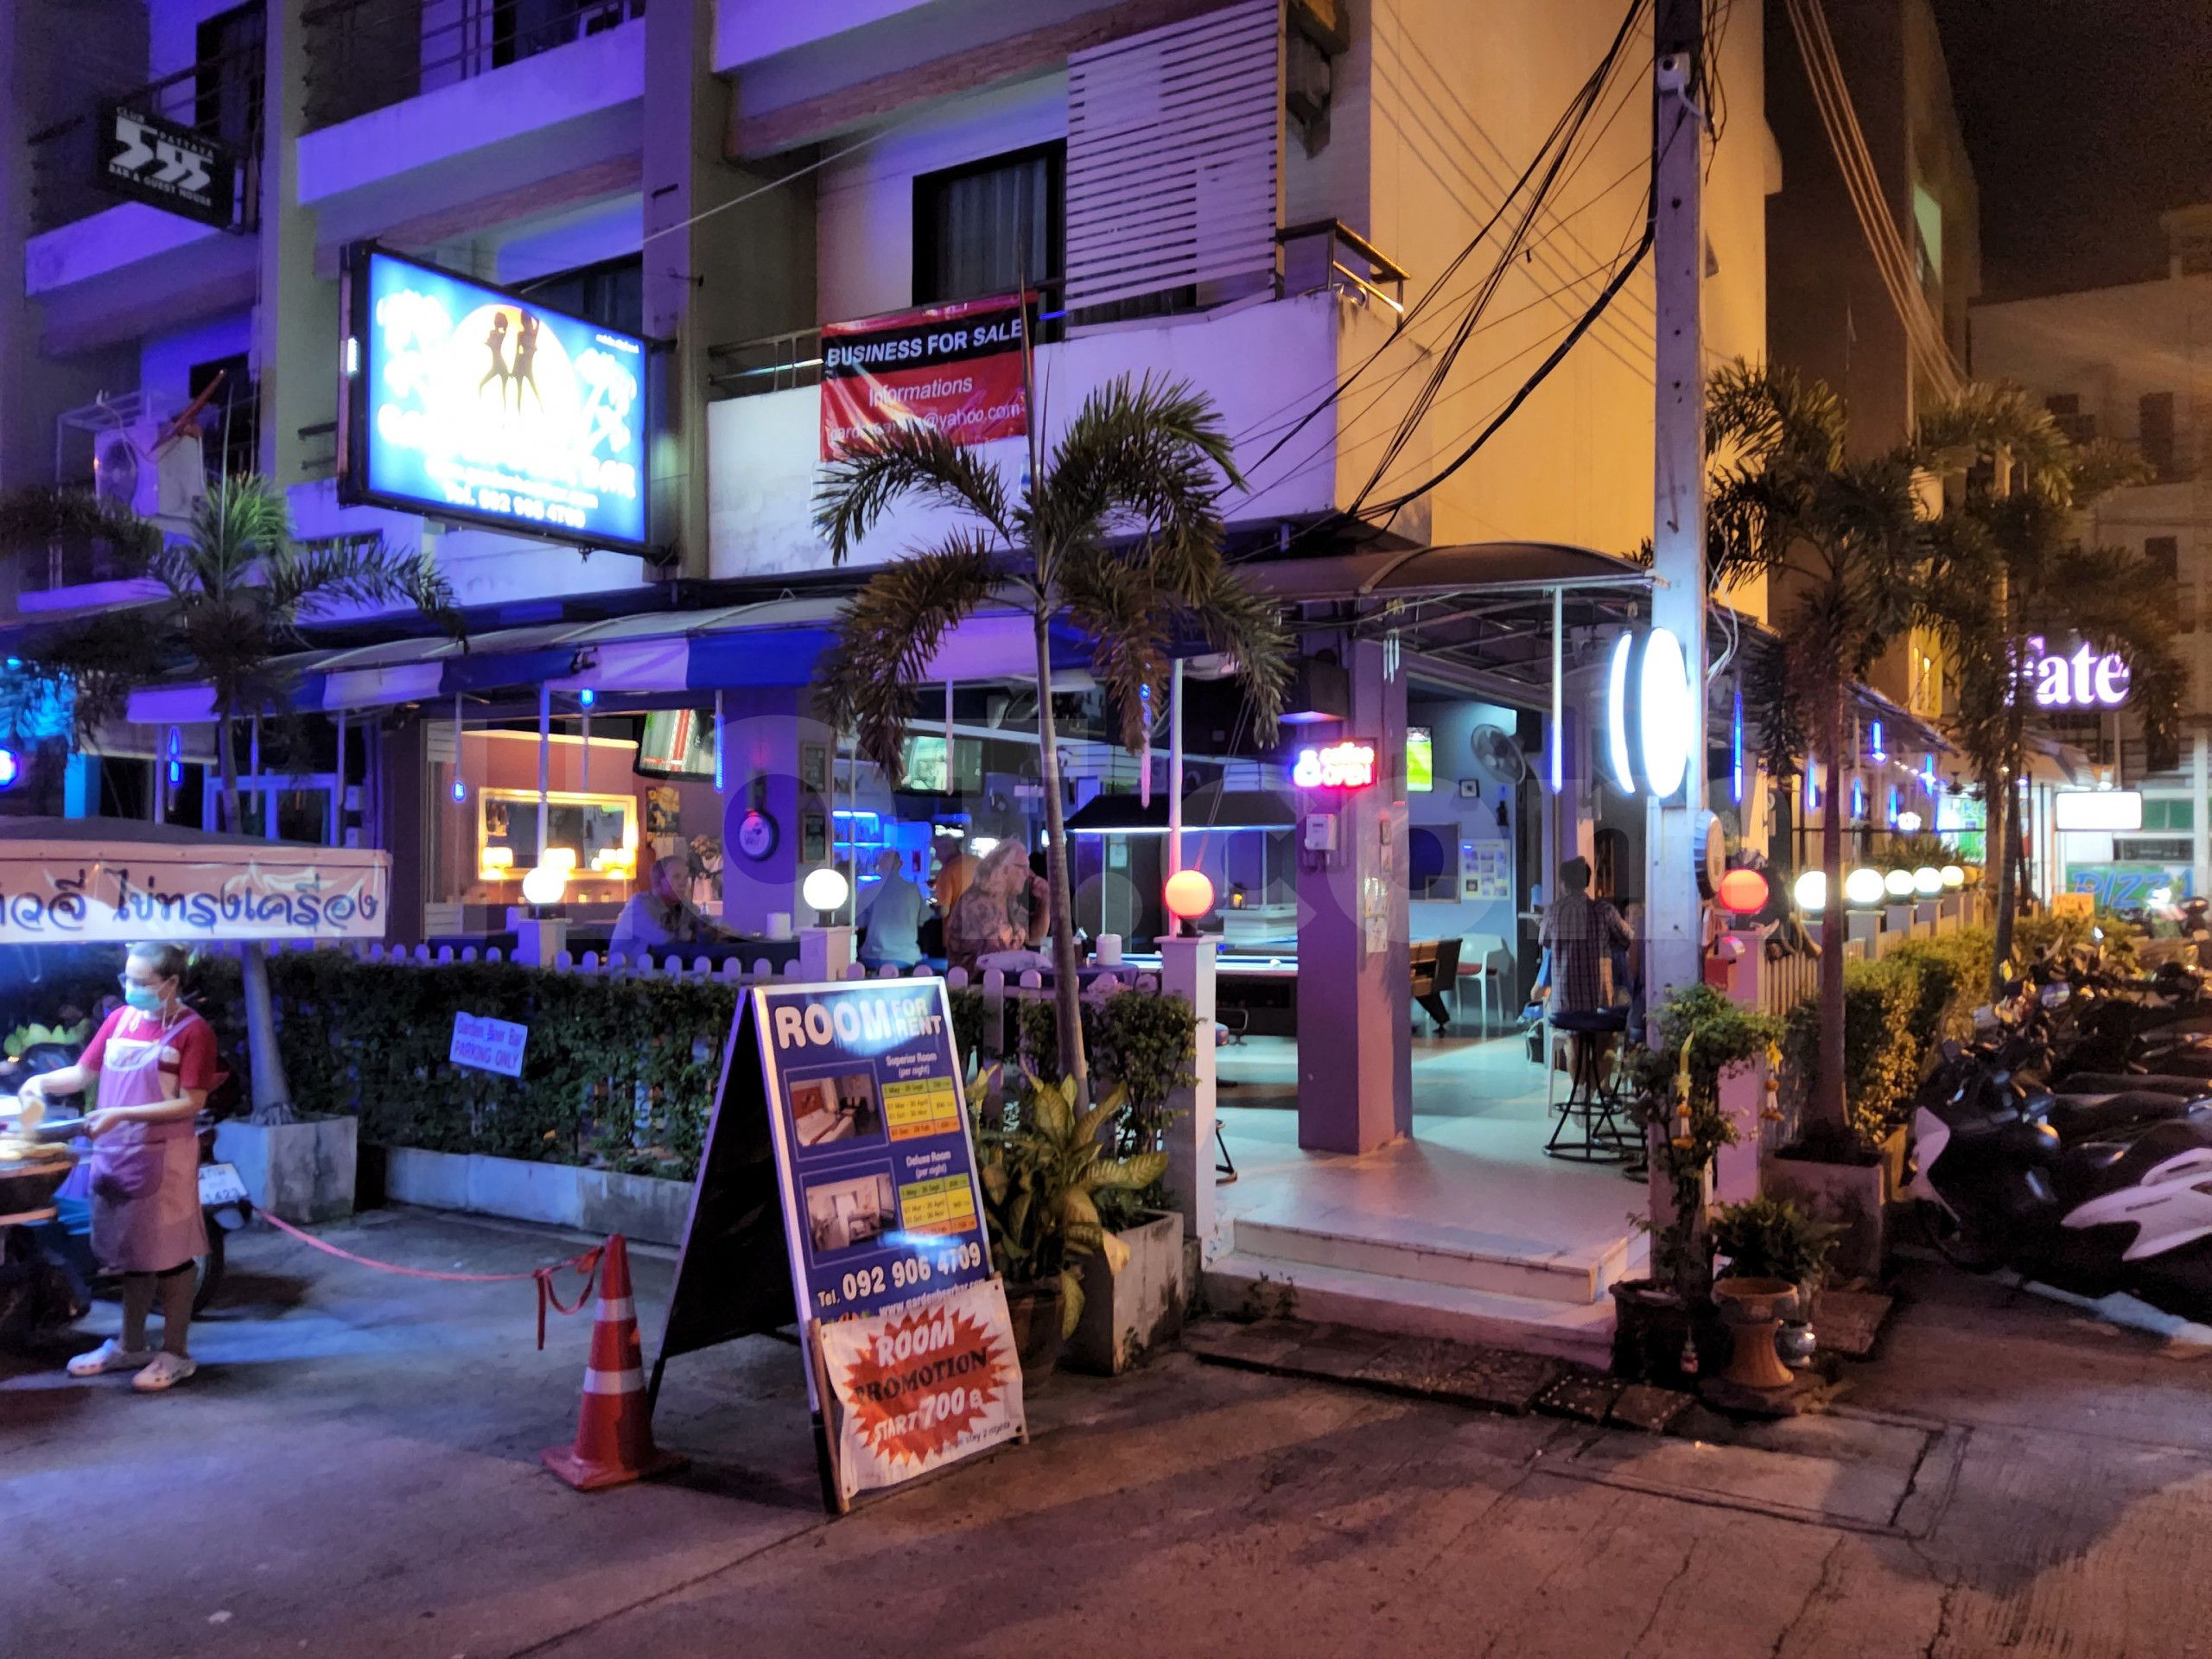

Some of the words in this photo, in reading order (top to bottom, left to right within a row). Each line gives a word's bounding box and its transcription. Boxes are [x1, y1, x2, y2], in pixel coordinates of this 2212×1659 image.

[827, 341, 923, 369] BUSINESS
[927, 330, 968, 356] FOR
[973, 318, 1022, 346] SALE
[869, 377, 973, 407] Informations
[775, 999, 892, 1050] ROOM
[892, 997, 928, 1017] FOR
[895, 1014, 942, 1036] RENT
[886, 1055, 916, 1067] Superior
[917, 1052, 938, 1062] Room
[931, 1151, 951, 1162] Room
[842, 1266, 887, 1300] 092
[892, 1255, 931, 1287] 906
[876, 1320, 955, 1368] ROOM
[855, 1346, 988, 1402] PROMOTION
[874, 1410, 918, 1443] START
[918, 1386, 965, 1430] 700
